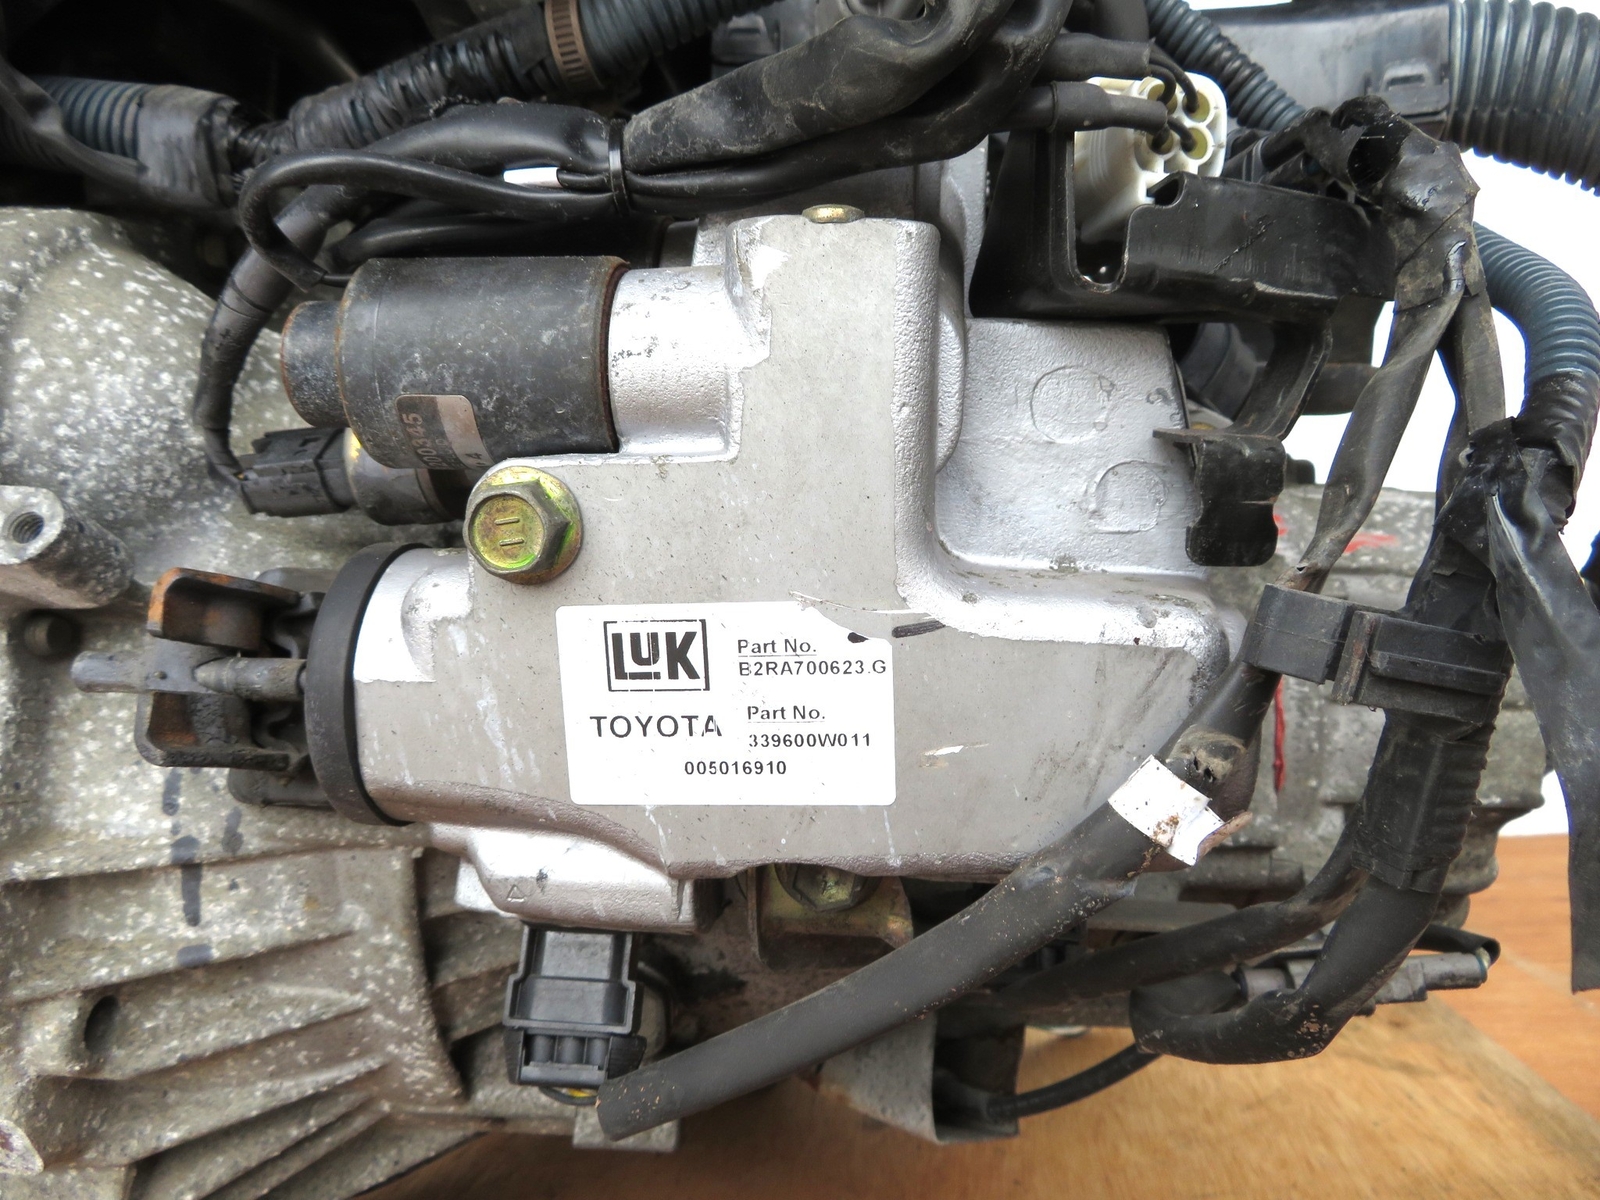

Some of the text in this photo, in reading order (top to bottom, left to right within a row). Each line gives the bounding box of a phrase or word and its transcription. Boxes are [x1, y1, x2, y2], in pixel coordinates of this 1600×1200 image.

[737, 636, 817, 654] Part No.
[739, 659, 887, 676] B2RA700623.G
[747, 705, 826, 720] Part No.
[589, 714, 723, 739] TOYOTA
[748, 732, 871, 747] 339600W011
[684, 760, 788, 776] 005016910
